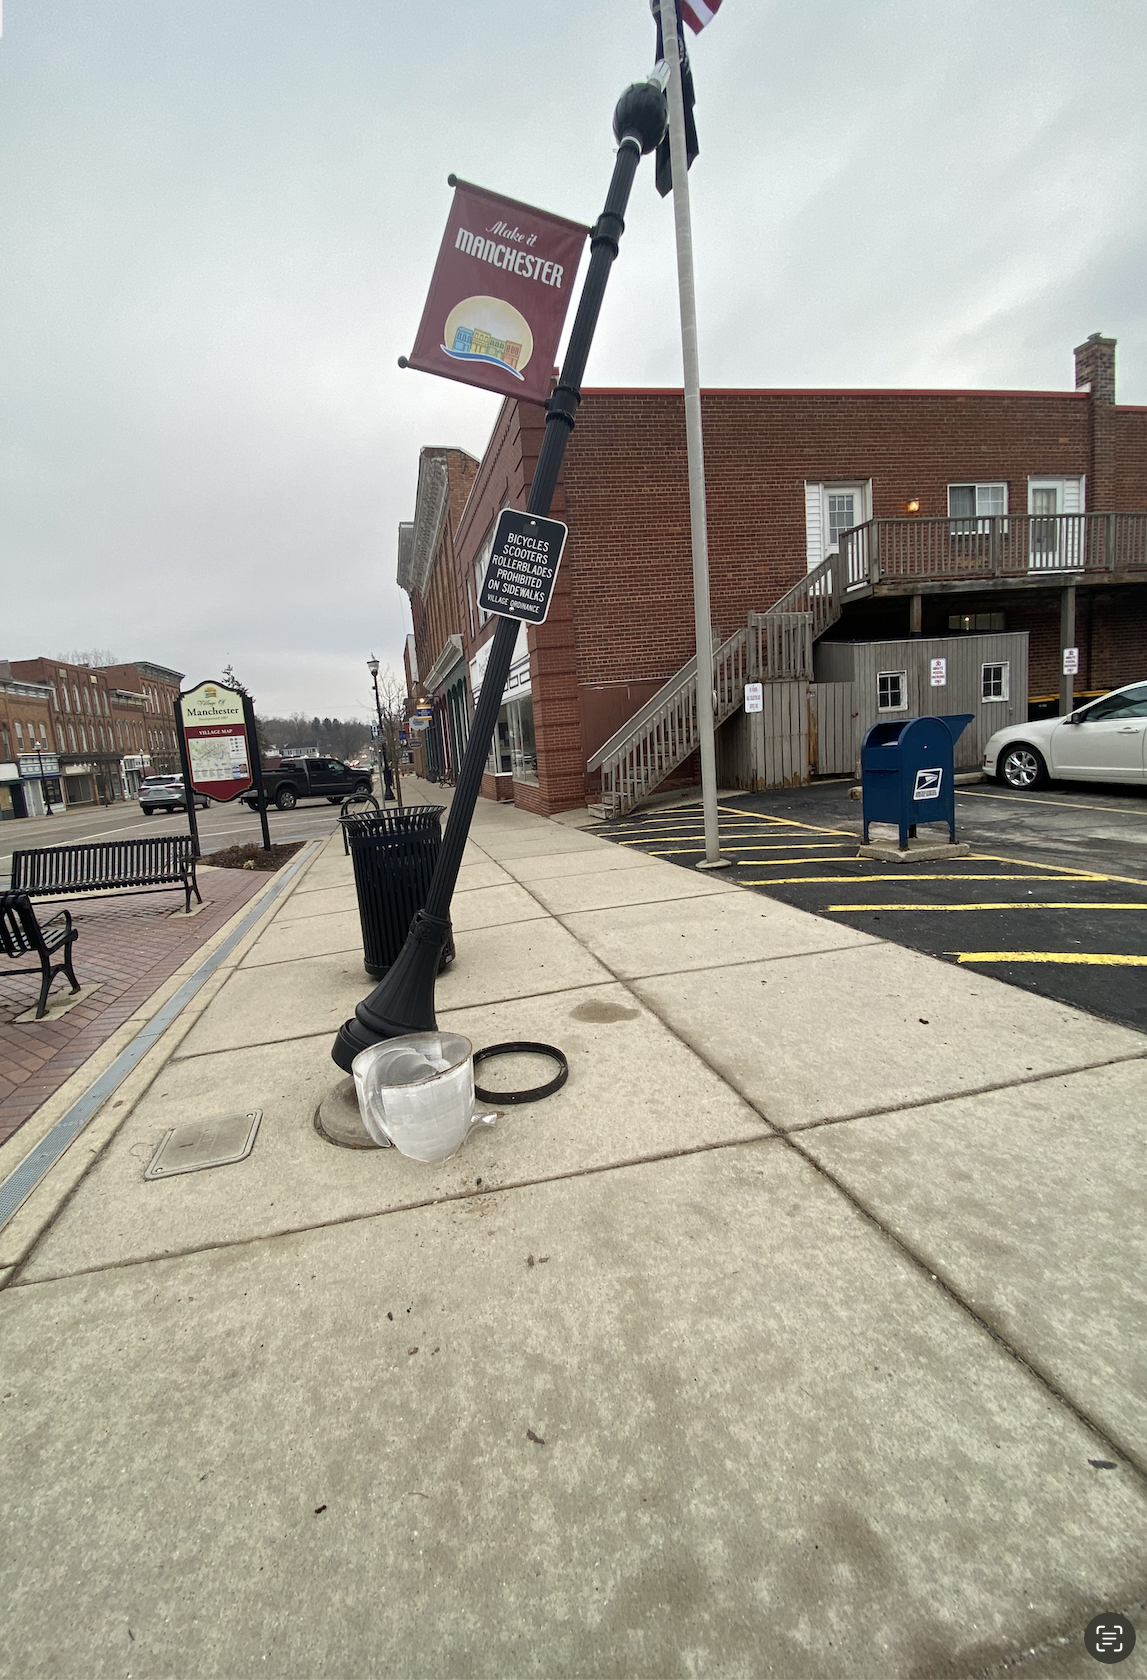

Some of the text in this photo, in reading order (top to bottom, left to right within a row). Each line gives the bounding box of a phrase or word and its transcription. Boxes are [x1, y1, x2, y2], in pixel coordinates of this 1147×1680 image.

[485, 221, 538, 247] Make it
[454, 227, 564, 288] MANCHESTER
[507, 532, 550, 552] BICYCLES
[502, 544, 549, 565] SCOOTERS
[492, 554, 553, 579] ROLLERBLADES
[496, 568, 543, 589] PROHIBITED
[488, 579, 546, 603] ON SIDEWALKS
[487, 593, 540, 614] VILLAGE ORDINANCE
[187, 707, 239, 716] Manchester
[197, 699, 216, 707] Village
